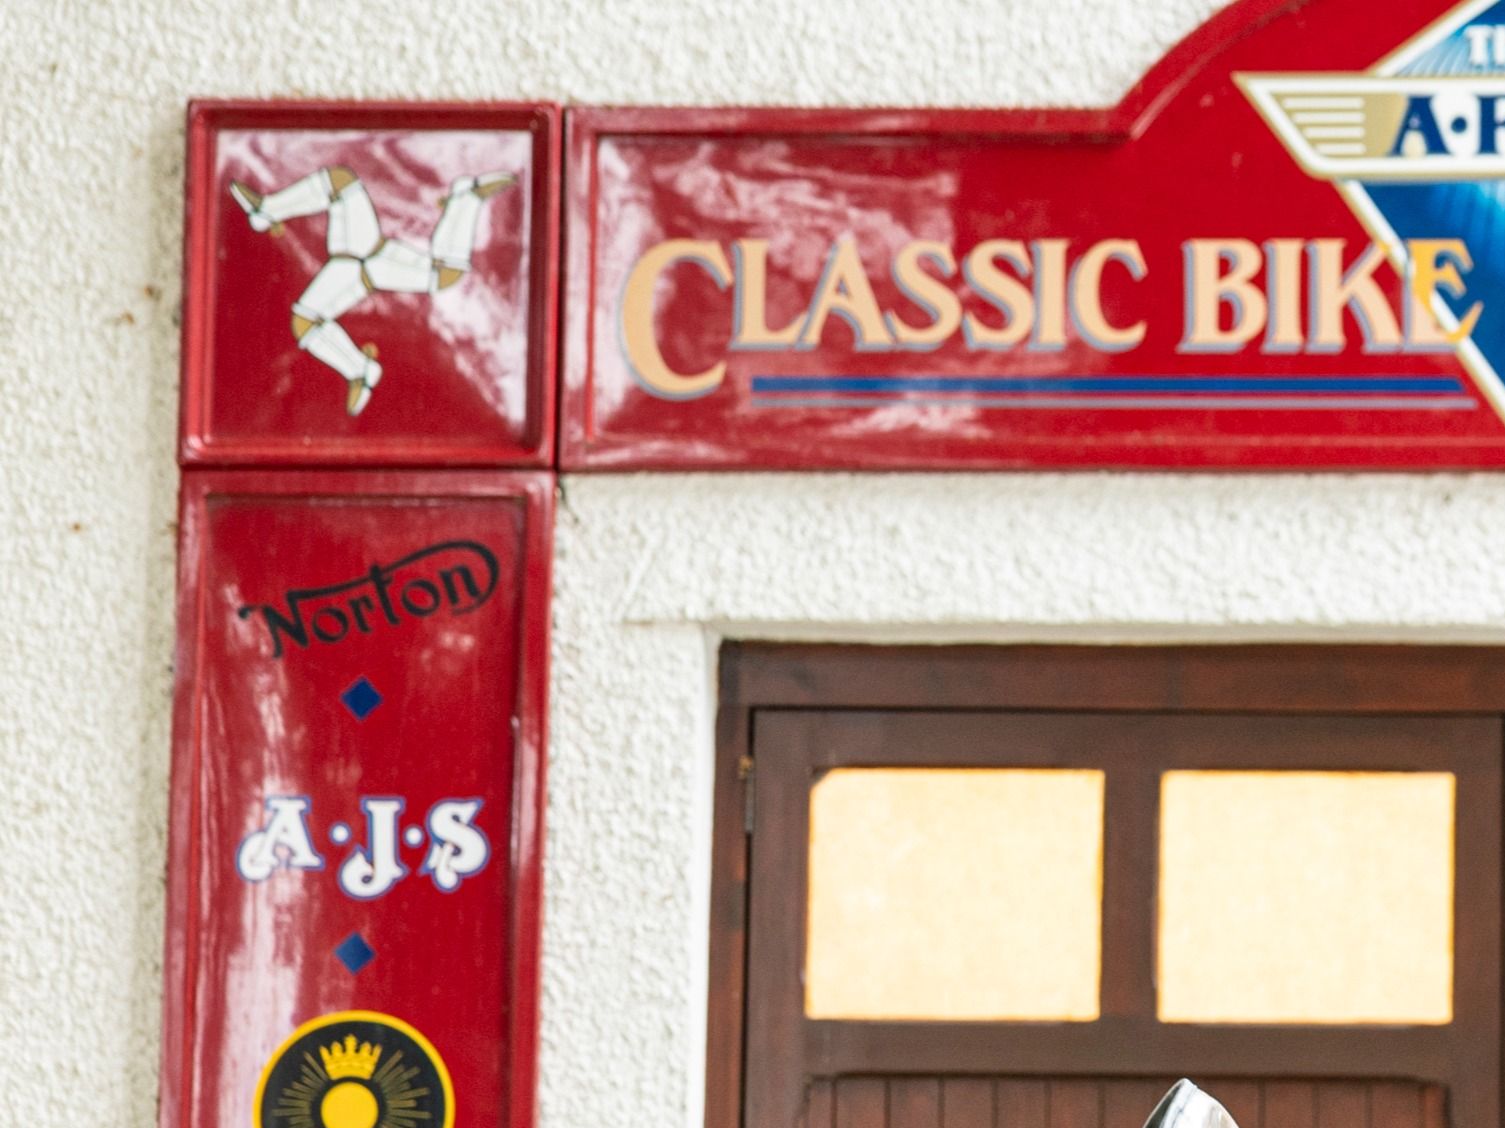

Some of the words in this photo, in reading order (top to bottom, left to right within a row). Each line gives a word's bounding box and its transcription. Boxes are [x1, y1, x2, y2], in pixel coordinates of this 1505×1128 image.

[617, 237, 1147, 401] CLASSIC
[1174, 237, 1484, 356] BIKE
[237, 540, 500, 659] Norton
